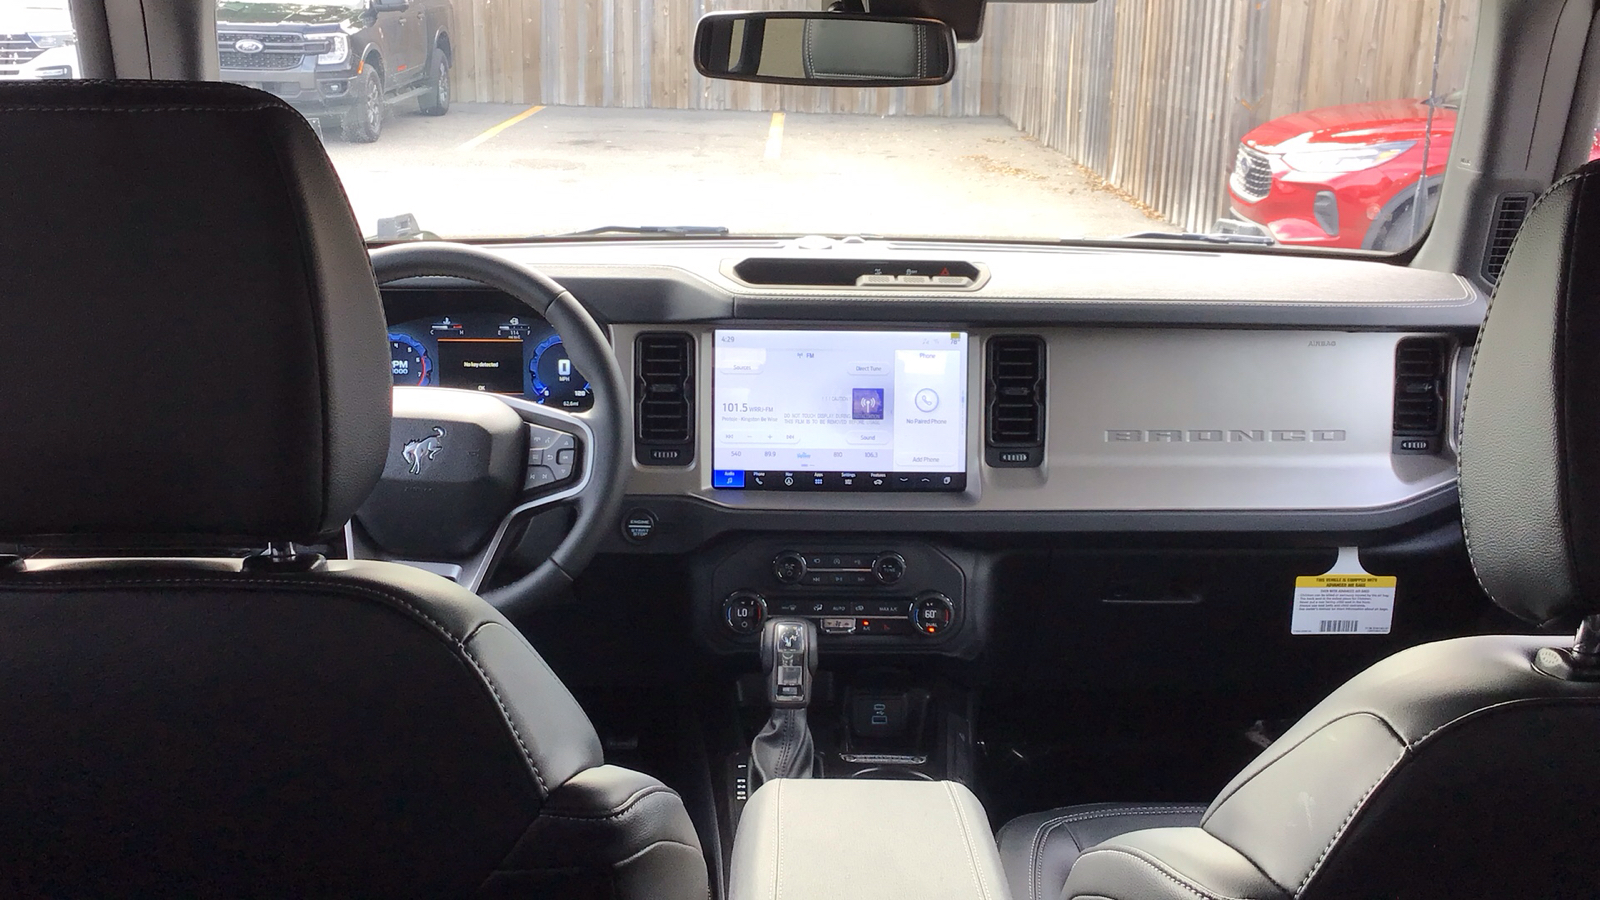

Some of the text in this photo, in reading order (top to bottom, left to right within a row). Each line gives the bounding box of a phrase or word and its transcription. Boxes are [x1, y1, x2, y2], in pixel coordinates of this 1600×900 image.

[391, 360, 409, 369] PM
[558, 359, 571, 376] 0
[722, 402, 748, 413] 101.5
[1104, 428, 1347, 443] BRONCO
[737, 608, 748, 617] LO
